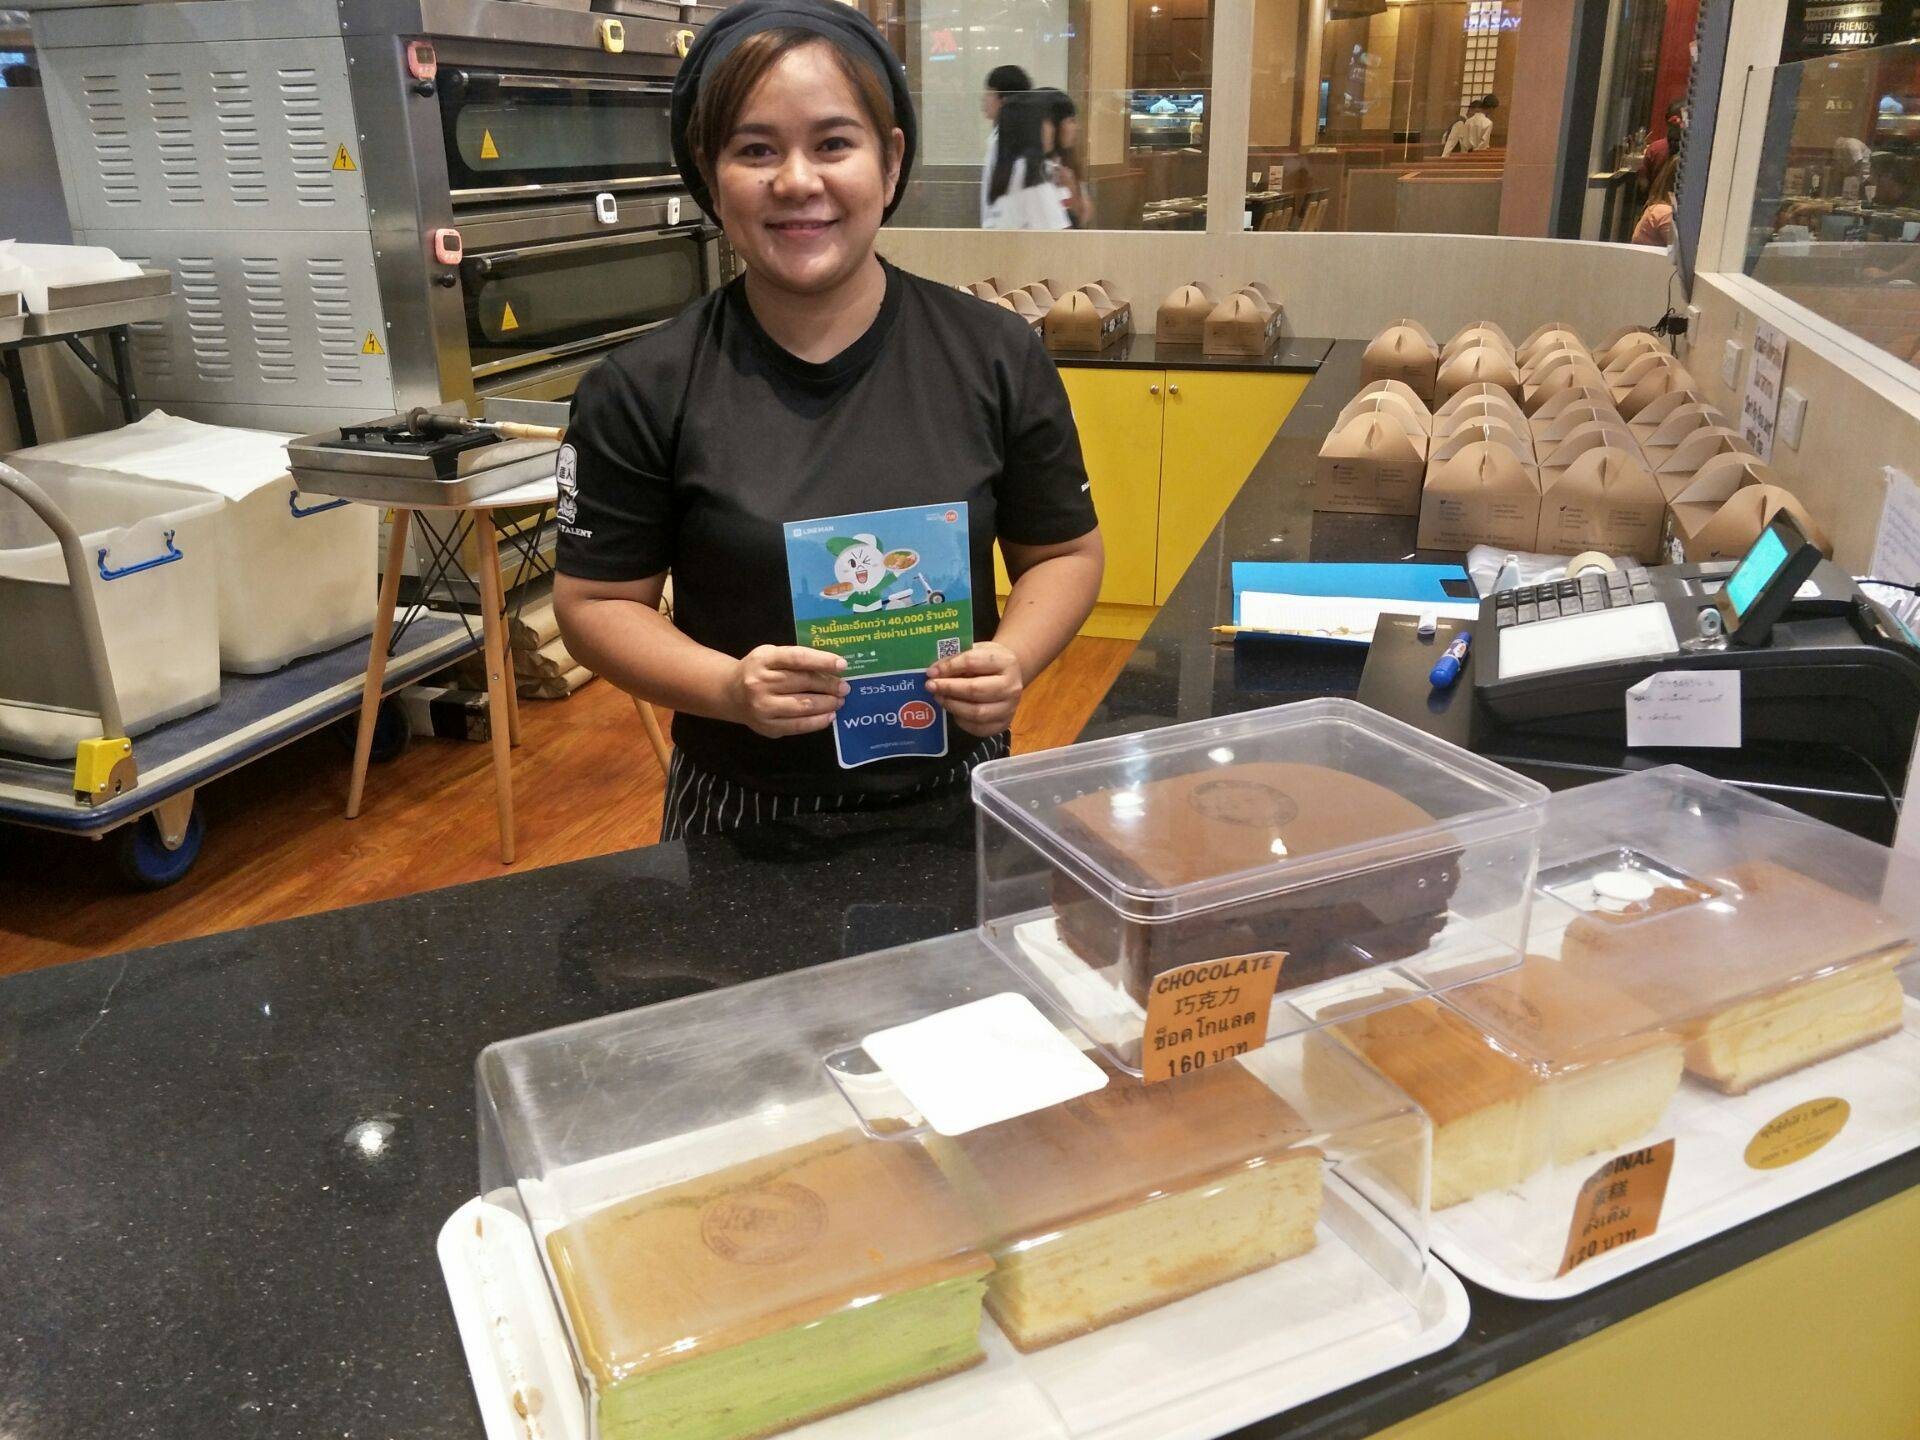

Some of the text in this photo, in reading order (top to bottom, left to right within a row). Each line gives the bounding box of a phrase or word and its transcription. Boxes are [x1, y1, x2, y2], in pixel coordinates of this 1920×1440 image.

[1833, 21, 1875, 31] FRIENDS
[1821, 32, 1878, 45] FAMILY
[561, 524, 593, 539] TALENT
[888, 613, 924, 625] 40,000
[909, 626, 934, 637] LINE
[934, 621, 959, 632] MAN
[1156, 955, 1274, 994] CHOCOLATE
[1173, 985, 1240, 1016] 巧克力
[1167, 1041, 1248, 1077] 160 บาท
